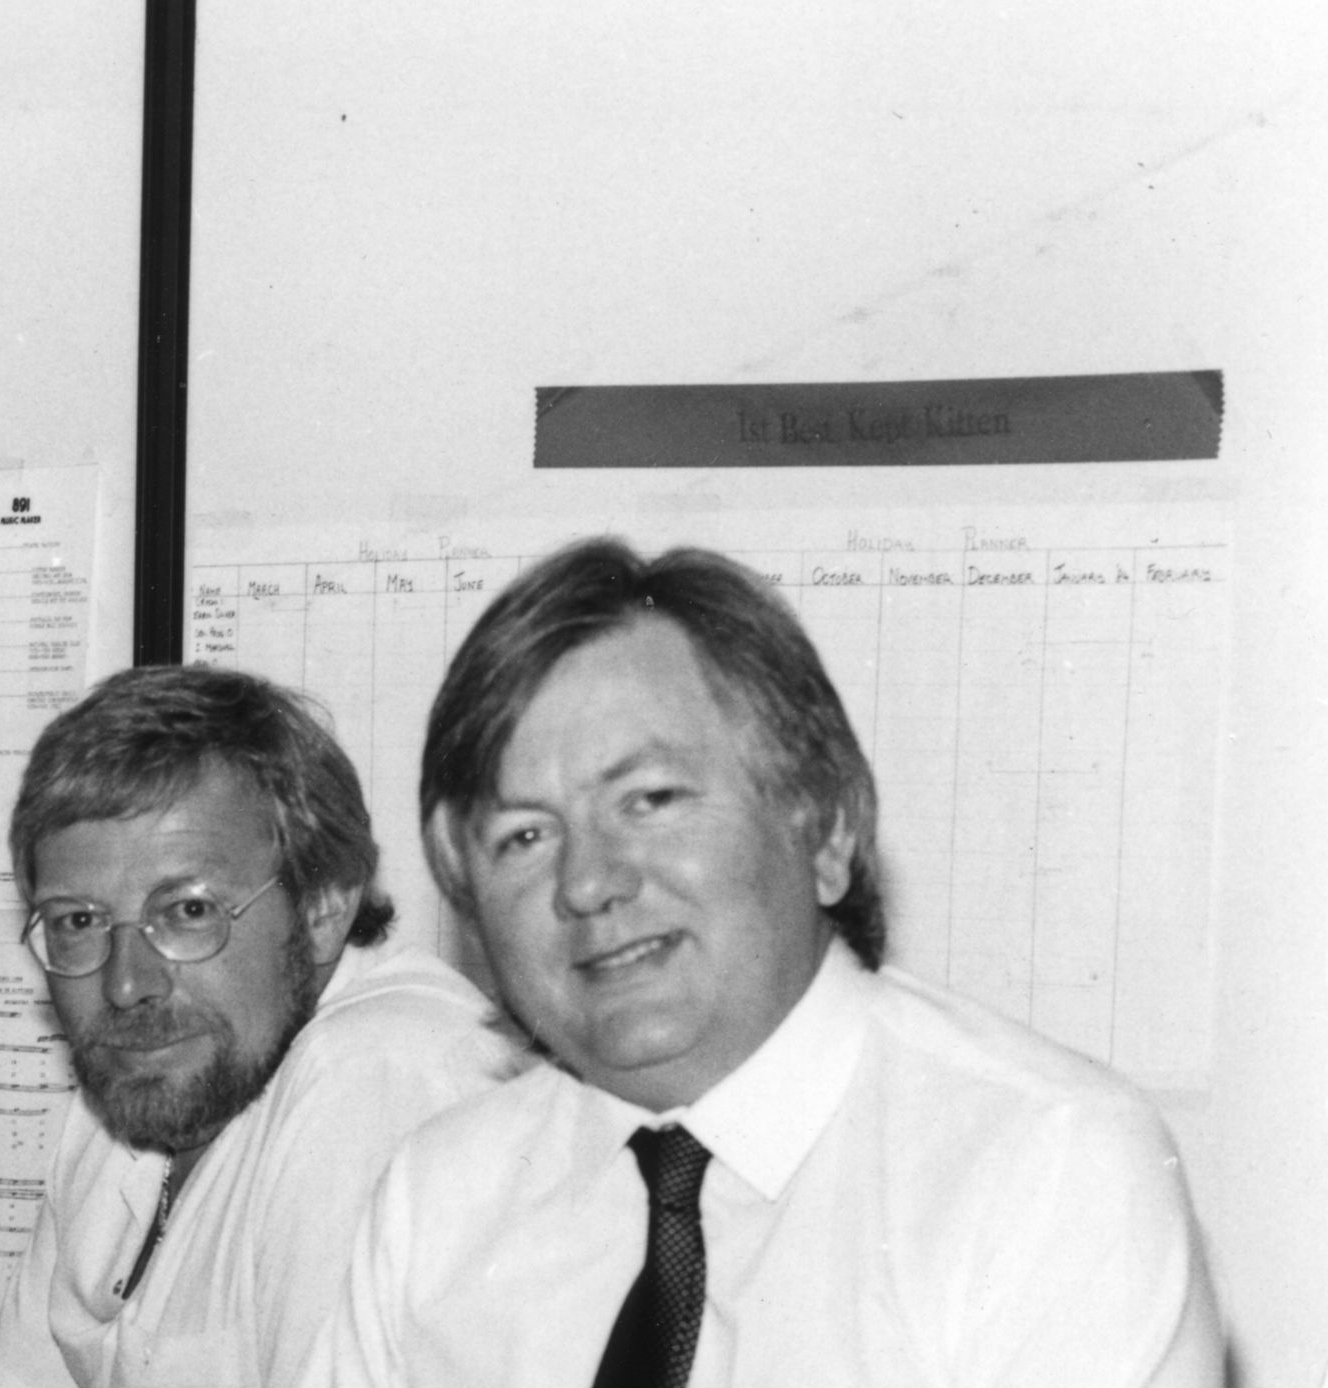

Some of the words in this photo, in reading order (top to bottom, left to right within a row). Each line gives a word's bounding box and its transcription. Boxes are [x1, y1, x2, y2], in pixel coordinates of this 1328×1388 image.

[780, 411, 834, 445] Best
[848, 407, 910, 446] Kept
[924, 405, 1011, 438] Kitten
[11, 497, 31, 513] 891
